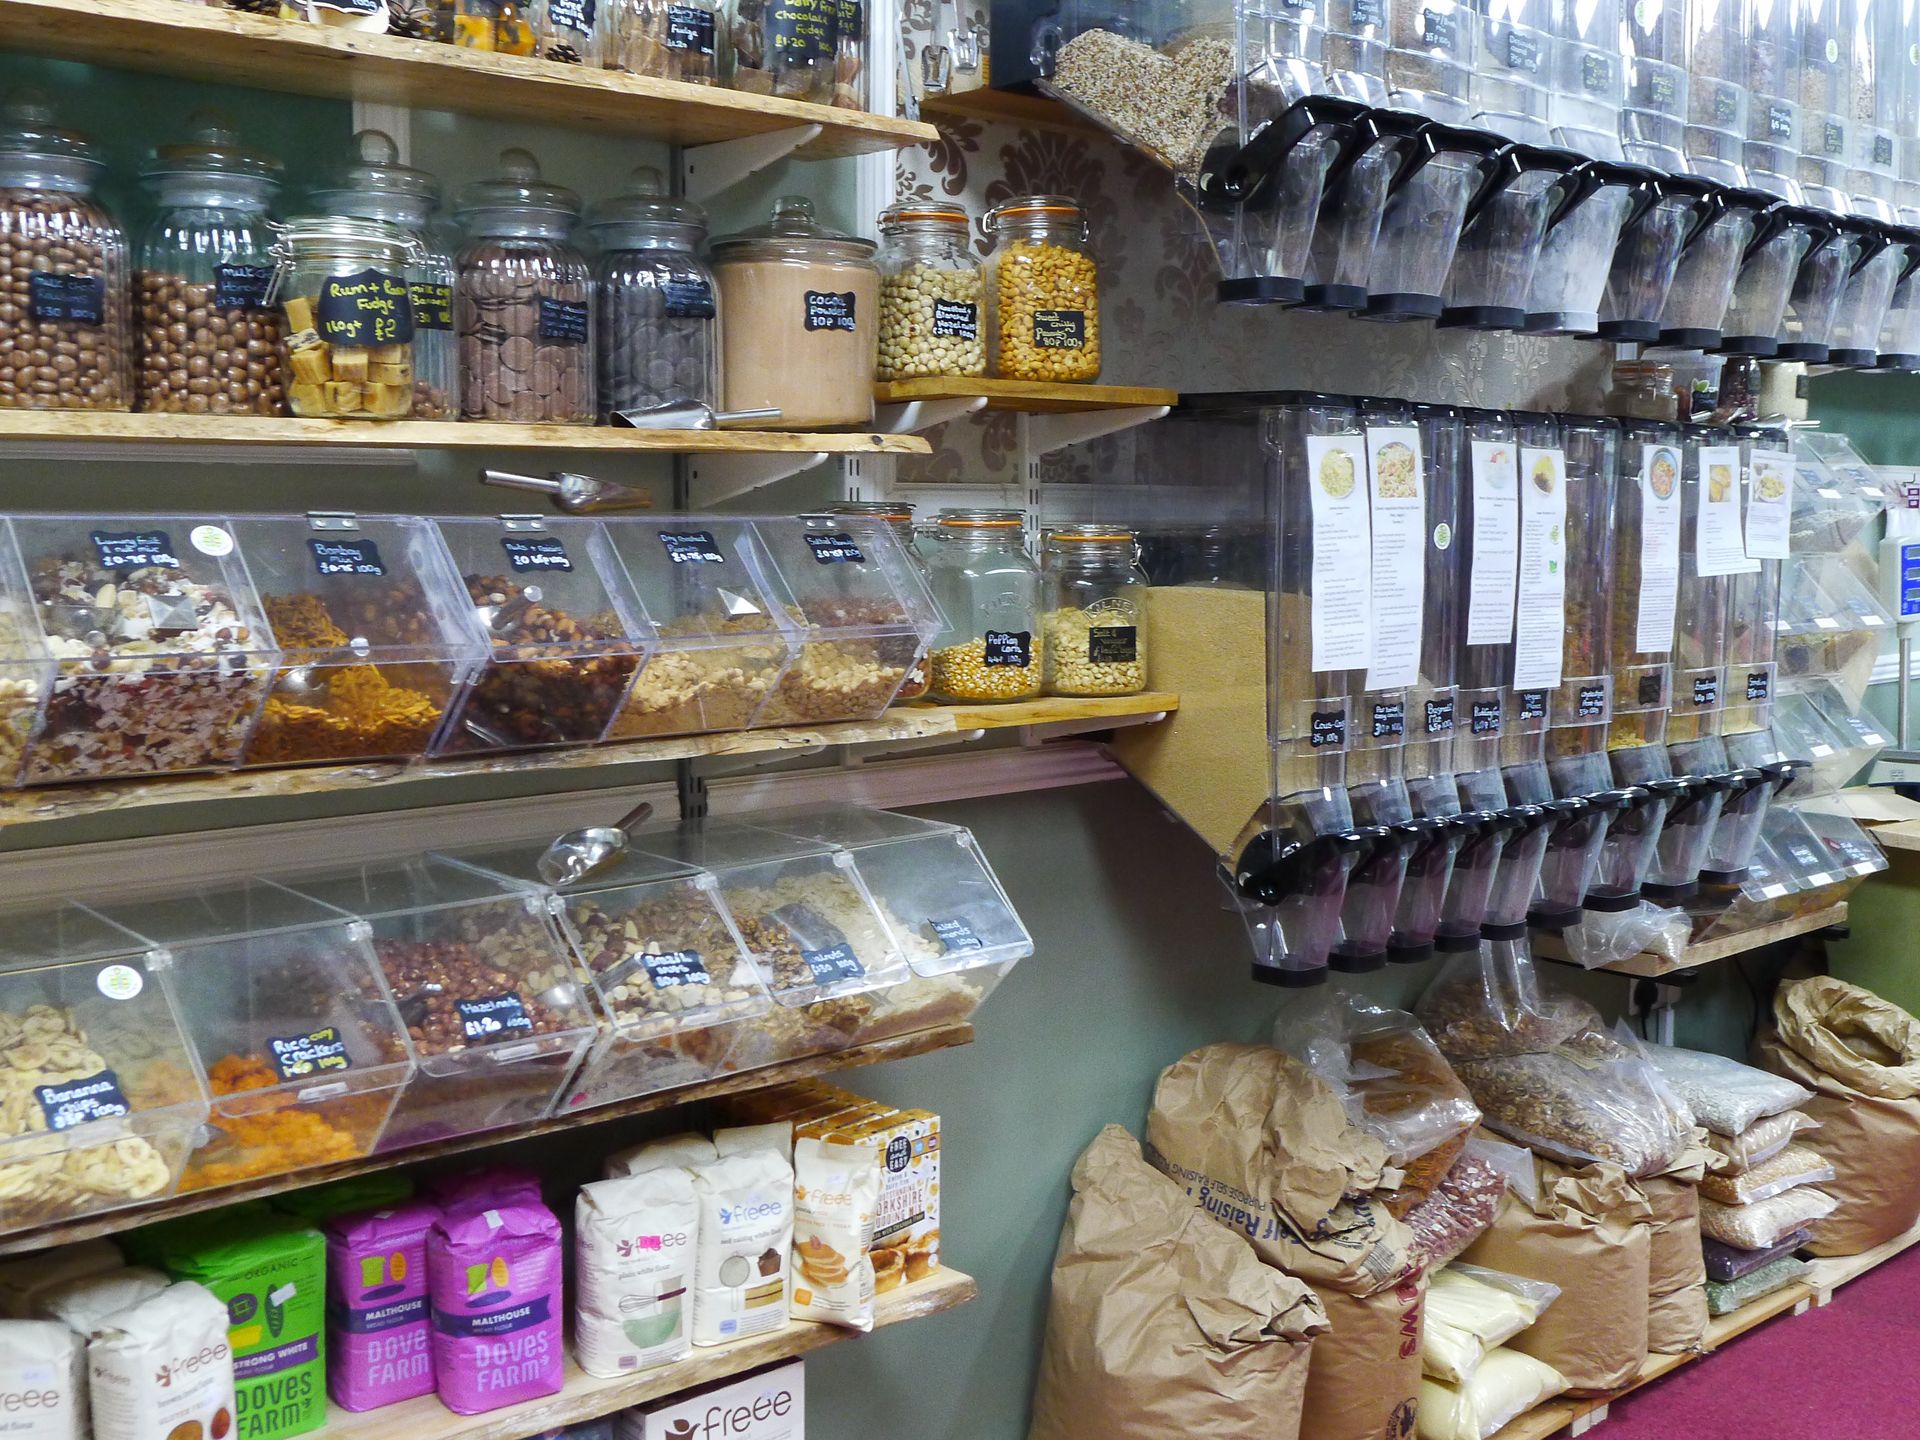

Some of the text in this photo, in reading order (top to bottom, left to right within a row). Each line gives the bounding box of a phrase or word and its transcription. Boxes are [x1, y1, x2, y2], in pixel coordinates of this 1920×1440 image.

[329, 283, 368, 298] Rum
[356, 297, 395, 316] Fudge
[375, 317, 397, 341] £2
[314, 543, 364, 561] Bombay
[273, 1037, 312, 1055] Rice
[732, 1201, 783, 1223] freee
[1199, 1186, 1260, 1239] Raising
[244, 1257, 299, 1281] ORGANIC
[365, 1300, 422, 1321] MALTHOUSE
[471, 1306, 531, 1327] MALTHOUSE
[172, 1342, 229, 1378] freee
[233, 1342, 309, 1371] STRONG WHITE
[367, 1352, 429, 1387] FARM
[476, 1358, 540, 1393] FARM
[703, 1390, 792, 1440] freee
